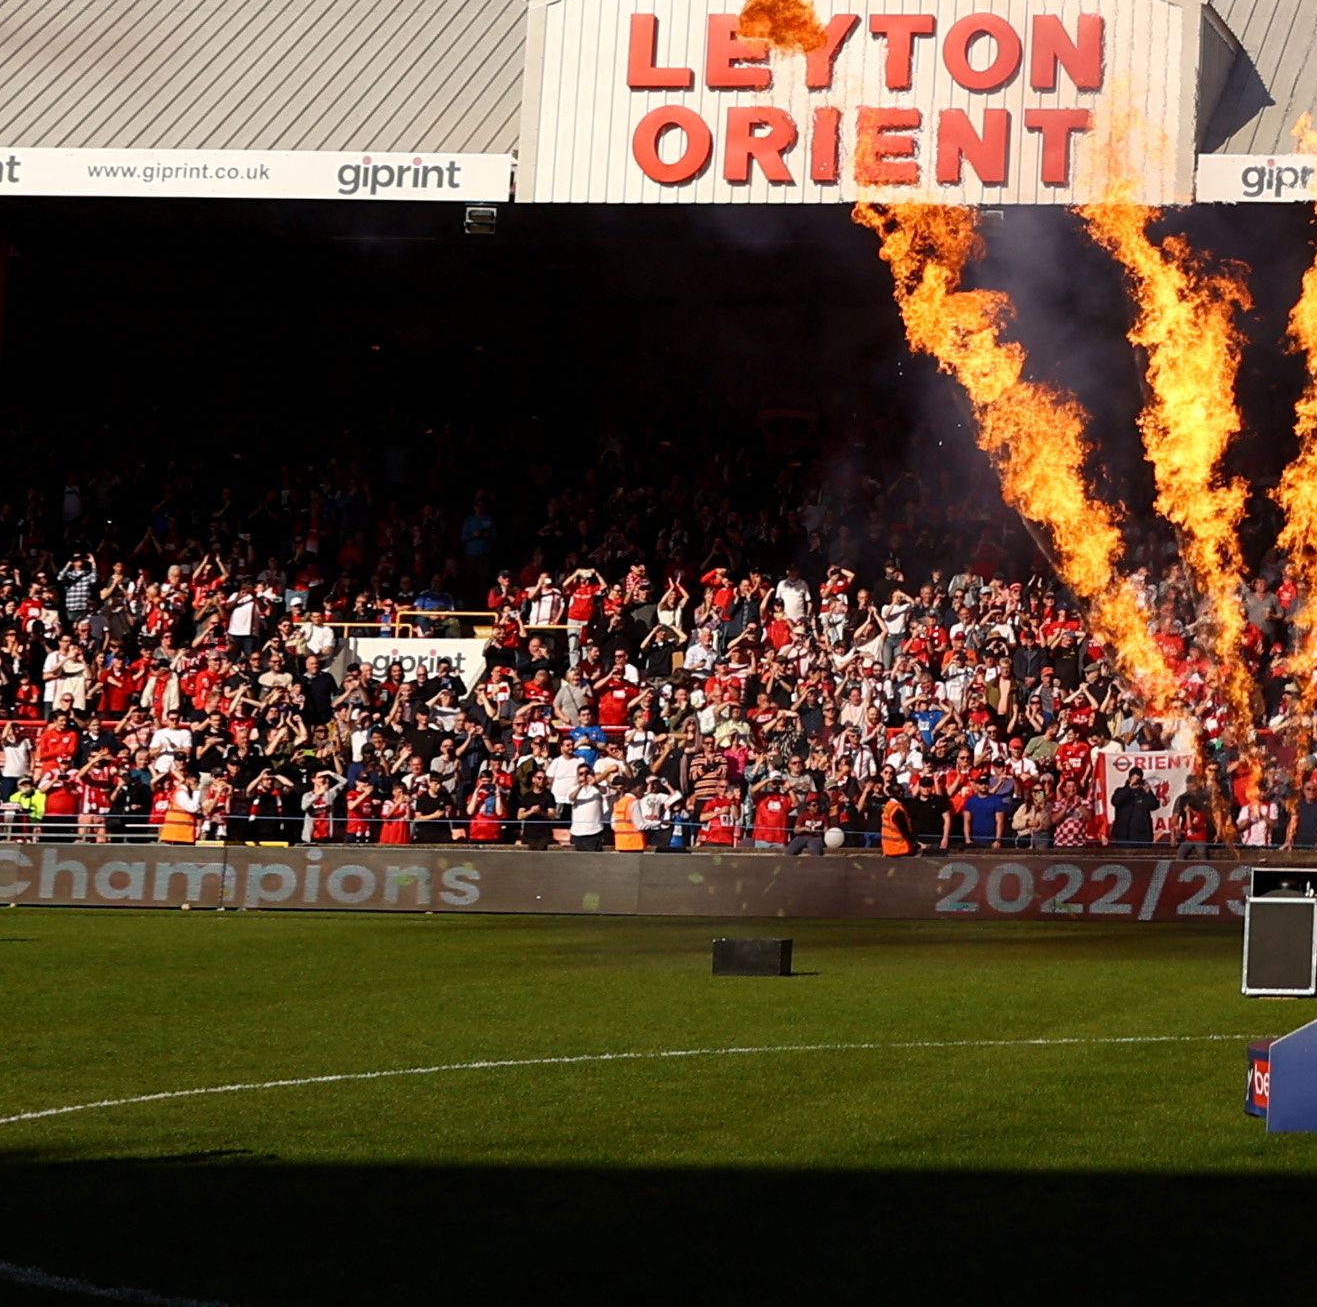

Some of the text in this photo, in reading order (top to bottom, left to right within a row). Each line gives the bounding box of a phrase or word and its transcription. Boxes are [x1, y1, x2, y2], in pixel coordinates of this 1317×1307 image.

[626, 11, 1106, 93] LEYTON
[87, 161, 271, 182] www.giprint.co.uk
[337, 155, 461, 195] giprint
[631, 103, 1093, 187] ORIENT
